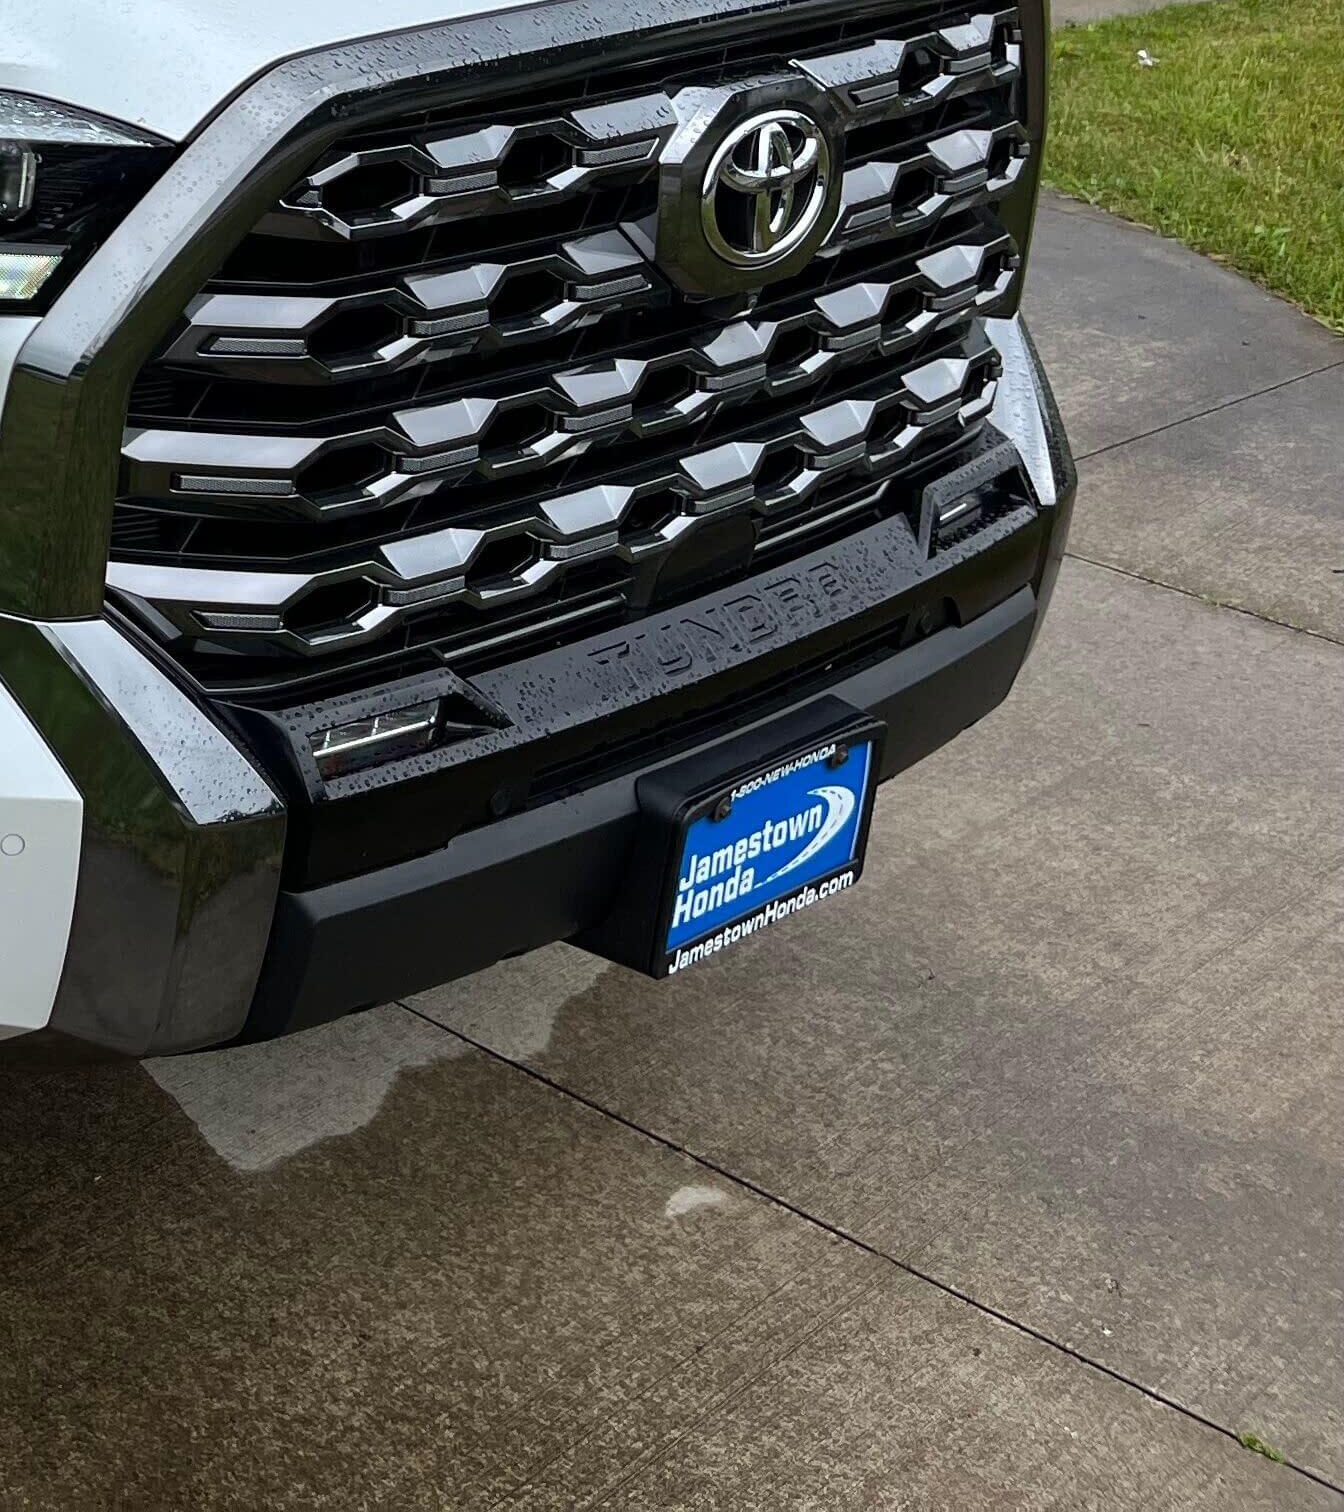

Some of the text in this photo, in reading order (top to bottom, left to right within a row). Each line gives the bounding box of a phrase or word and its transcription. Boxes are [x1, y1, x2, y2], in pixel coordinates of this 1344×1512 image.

[679, 803, 823, 893] Jamestown
[668, 870, 854, 975] JamestownHonda.com
[671, 864, 755, 928] Honda
